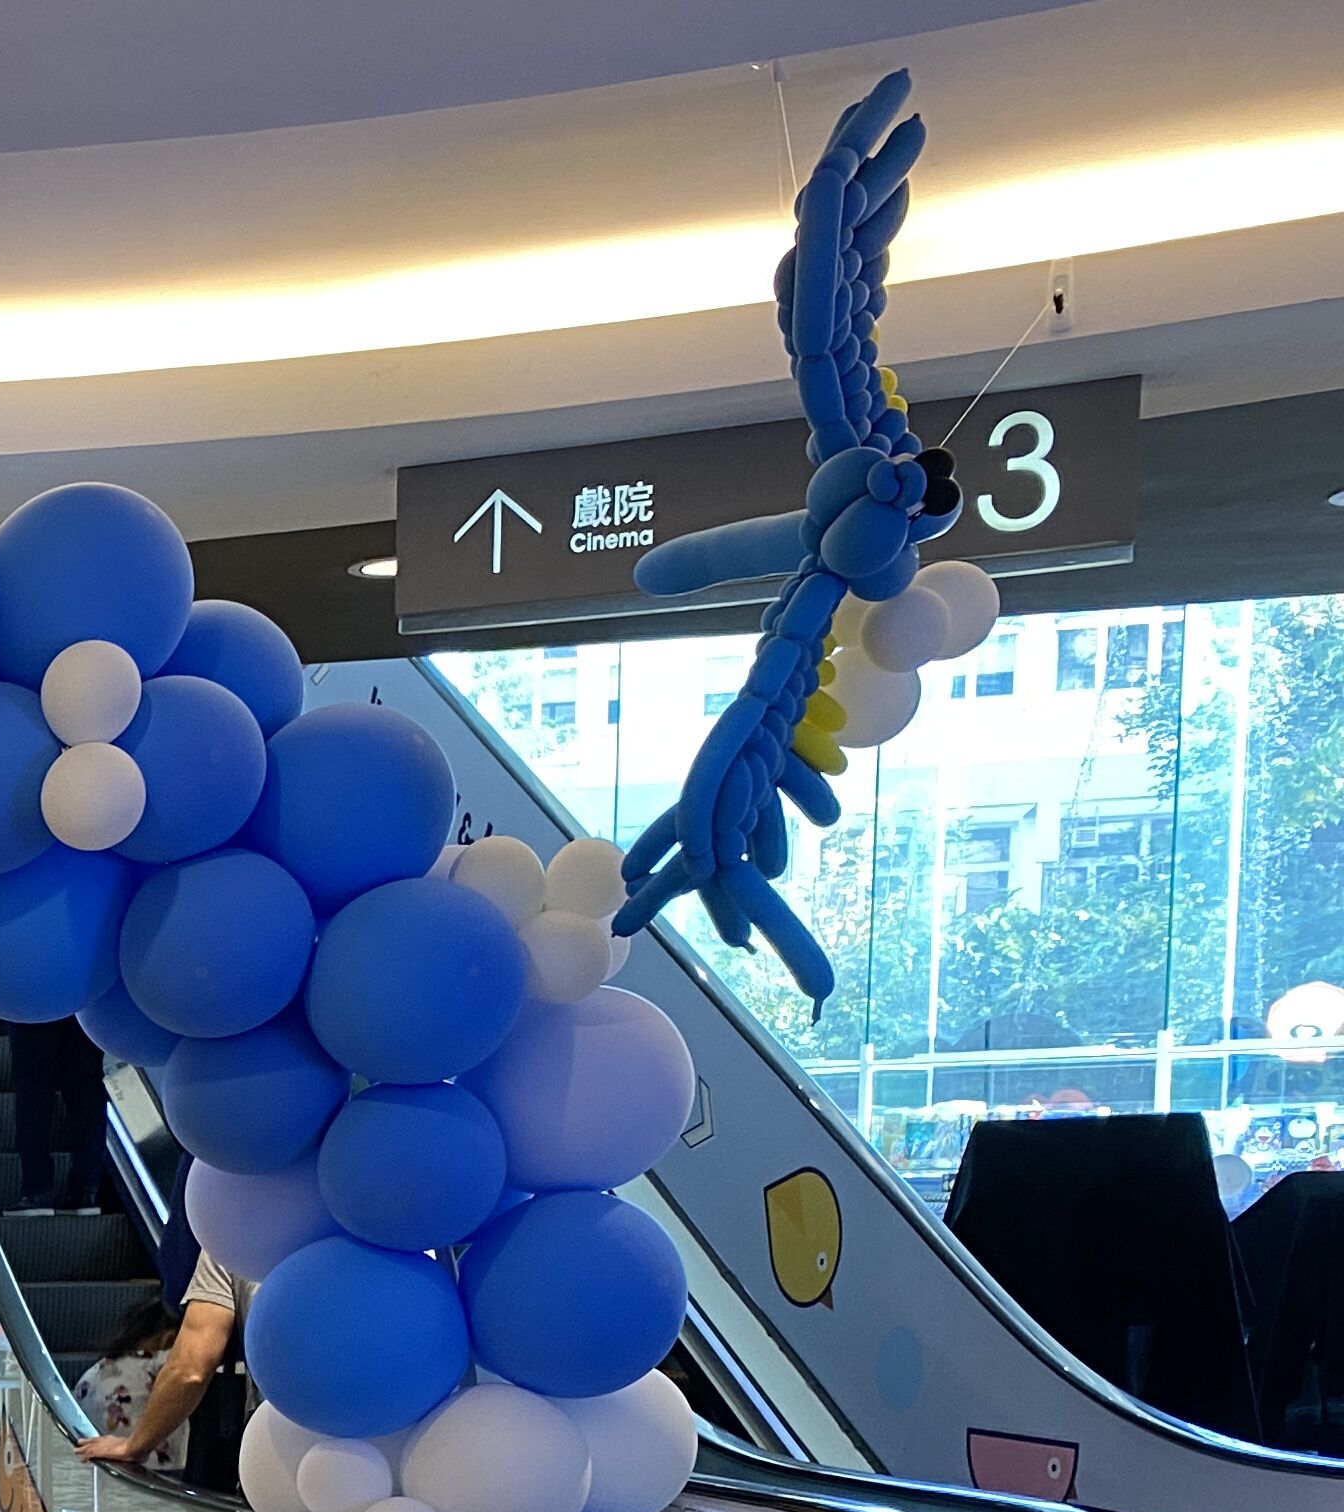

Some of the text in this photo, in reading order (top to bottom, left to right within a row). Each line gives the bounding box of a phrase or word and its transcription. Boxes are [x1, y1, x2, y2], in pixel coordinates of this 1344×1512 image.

[976, 410, 1061, 533] 3
[571, 481, 655, 530] 戲院
[570, 526, 655, 556] Cinema
